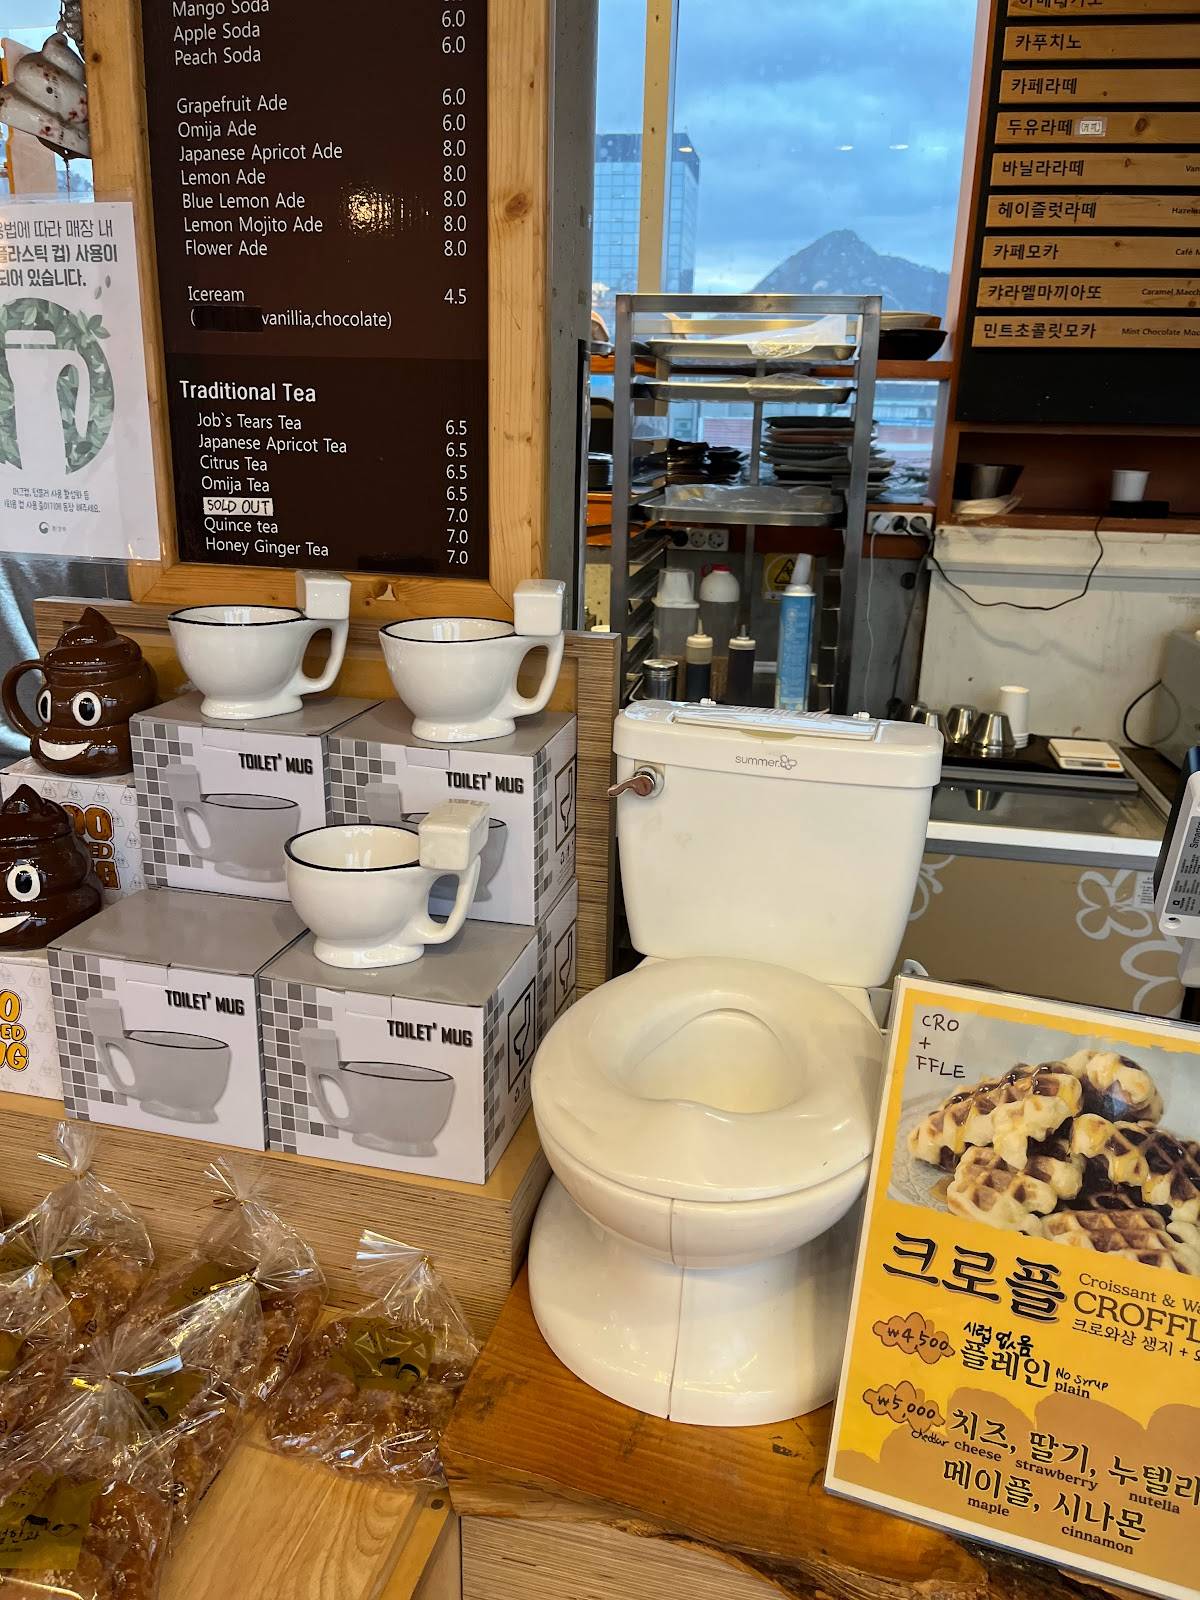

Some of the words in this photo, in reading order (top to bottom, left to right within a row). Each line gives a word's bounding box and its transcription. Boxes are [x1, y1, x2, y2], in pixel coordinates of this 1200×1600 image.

[173, 1, 225, 20] Mango
[232, 0, 269, 13] Soda
[442, 10, 465, 27] 6.0
[174, 24, 216, 45] Apple
[223, 21, 260, 38] Soda
[442, 36, 465, 53] 6.0
[1015, 34, 1082, 51] 카푸치노
[175, 48, 217, 65] Peach
[224, 46, 260, 63] Soda
[1011, 78, 1077, 94] 카페라떼
[443, 88, 465, 105] 6.0
[177, 95, 251, 117] Grapefruit
[257, 94, 287, 110] Ade
[178, 121, 220, 141] Omija
[227, 120, 256, 136] Ade
[443, 114, 465, 131] 6.0
[1007, 119, 1072, 136] 두유라떼
[179, 146, 245, 165] Japanese
[251, 144, 306, 164] Apricot
[312, 142, 342, 158] Ade
[443, 140, 465, 156] 8.0
[182, 170, 230, 185] Lemon
[237, 168, 265, 184] Ade
[444, 165, 466, 182] 8.0
[1002, 160, 1084, 177] 바닐라라떼
[183, 193, 213, 208] Blue
[220, 193, 269, 208] Lemon
[276, 192, 305, 208] Ade
[444, 190, 466, 207] 8.0
[998, 202, 1096, 219] 헤이즐럿라떼
[34, 221, 61, 238] 따라
[66, 220, 93, 237] 매장
[99, 220, 112, 237] 내
[185, 217, 232, 232] Lemon
[240, 217, 286, 236] Mojito
[293, 216, 322, 232] Ade
[444, 215, 466, 231] 8.0
[52, 245, 70, 262] 컵)
[76, 244, 117, 262] 사용이
[186, 239, 232, 255] Flower
[239, 240, 267, 255] Ade
[445, 240, 466, 256] 8.0
[993, 244, 1058, 260] 카페모카
[28, 269, 86, 286] 있습니다.
[188, 286, 244, 301] Iceream
[444, 289, 466, 304] 4.5
[988, 284, 1101, 300] 카라멜마끼아또
[984, 323, 1096, 339] 민트초콜릿모카
[180, 381, 275, 400] Traditional
[283, 383, 315, 402] Tea
[237, 414, 272, 429] Tears
[278, 415, 301, 430] Tea
[446, 420, 466, 435] 6.5
[199, 434, 260, 452] Japanese
[266, 437, 318, 454] Apricot
[323, 438, 346, 453] Tea
[446, 442, 467, 457] 6.5
[200, 455, 239, 470] Citrus
[244, 457, 267, 471] Tea
[447, 465, 467, 479] 6.5
[202, 476, 241, 494] Omija
[247, 478, 269, 492] Tea
[447, 486, 467, 501] 6.5
[208, 499, 236, 513] SOLD
[242, 500, 269, 514] OUT
[447, 508, 467, 522] 7.0
[205, 517, 251, 533] Quince
[257, 521, 278, 533] tea
[447, 529, 468, 543] 7.0
[206, 537, 249, 555] Honey
[255, 540, 300, 557] Ginger
[306, 542, 328, 556] Tea
[447, 550, 468, 564] 7.0
[286, 757, 313, 775] MUG
[496, 776, 524, 794] MUG
[215, 996, 244, 1015] MUG
[922, 1014, 959, 1032] CRO
[441, 1026, 472, 1046] MUG
[916, 1056, 965, 1078] FFLE
[883, 1232, 1066, 1322] 크로플
[1079, 1273, 1156, 1302] Croissant
[1163, 1294, 1176, 1307] &
[964, 1322, 992, 1344] 시럽
[996, 1331, 1034, 1357] 없음
[1072, 1319, 1136, 1346] 크로와상
[1141, 1336, 1172, 1356] 생지
[1180, 1348, 1188, 1356] +
[961, 1339, 1050, 1388] 플레인
[1057, 1368, 1071, 1381] No
[1055, 1380, 1090, 1398] plain
[950, 1409, 1017, 1454] 치즈,
[1030, 1431, 1096, 1478] 딸기,
[1109, 1456, 1200, 1506] 누텔라
[954, 1439, 1002, 1461] cheese
[1015, 1460, 1099, 1491] strawberry
[1129, 1492, 1180, 1515] nutella
[943, 1459, 1041, 1512] 메이플,
[1054, 1493, 1146, 1540] 시나몬
[967, 1497, 1009, 1517] maple
[1061, 1525, 1134, 1555] cinnamon
